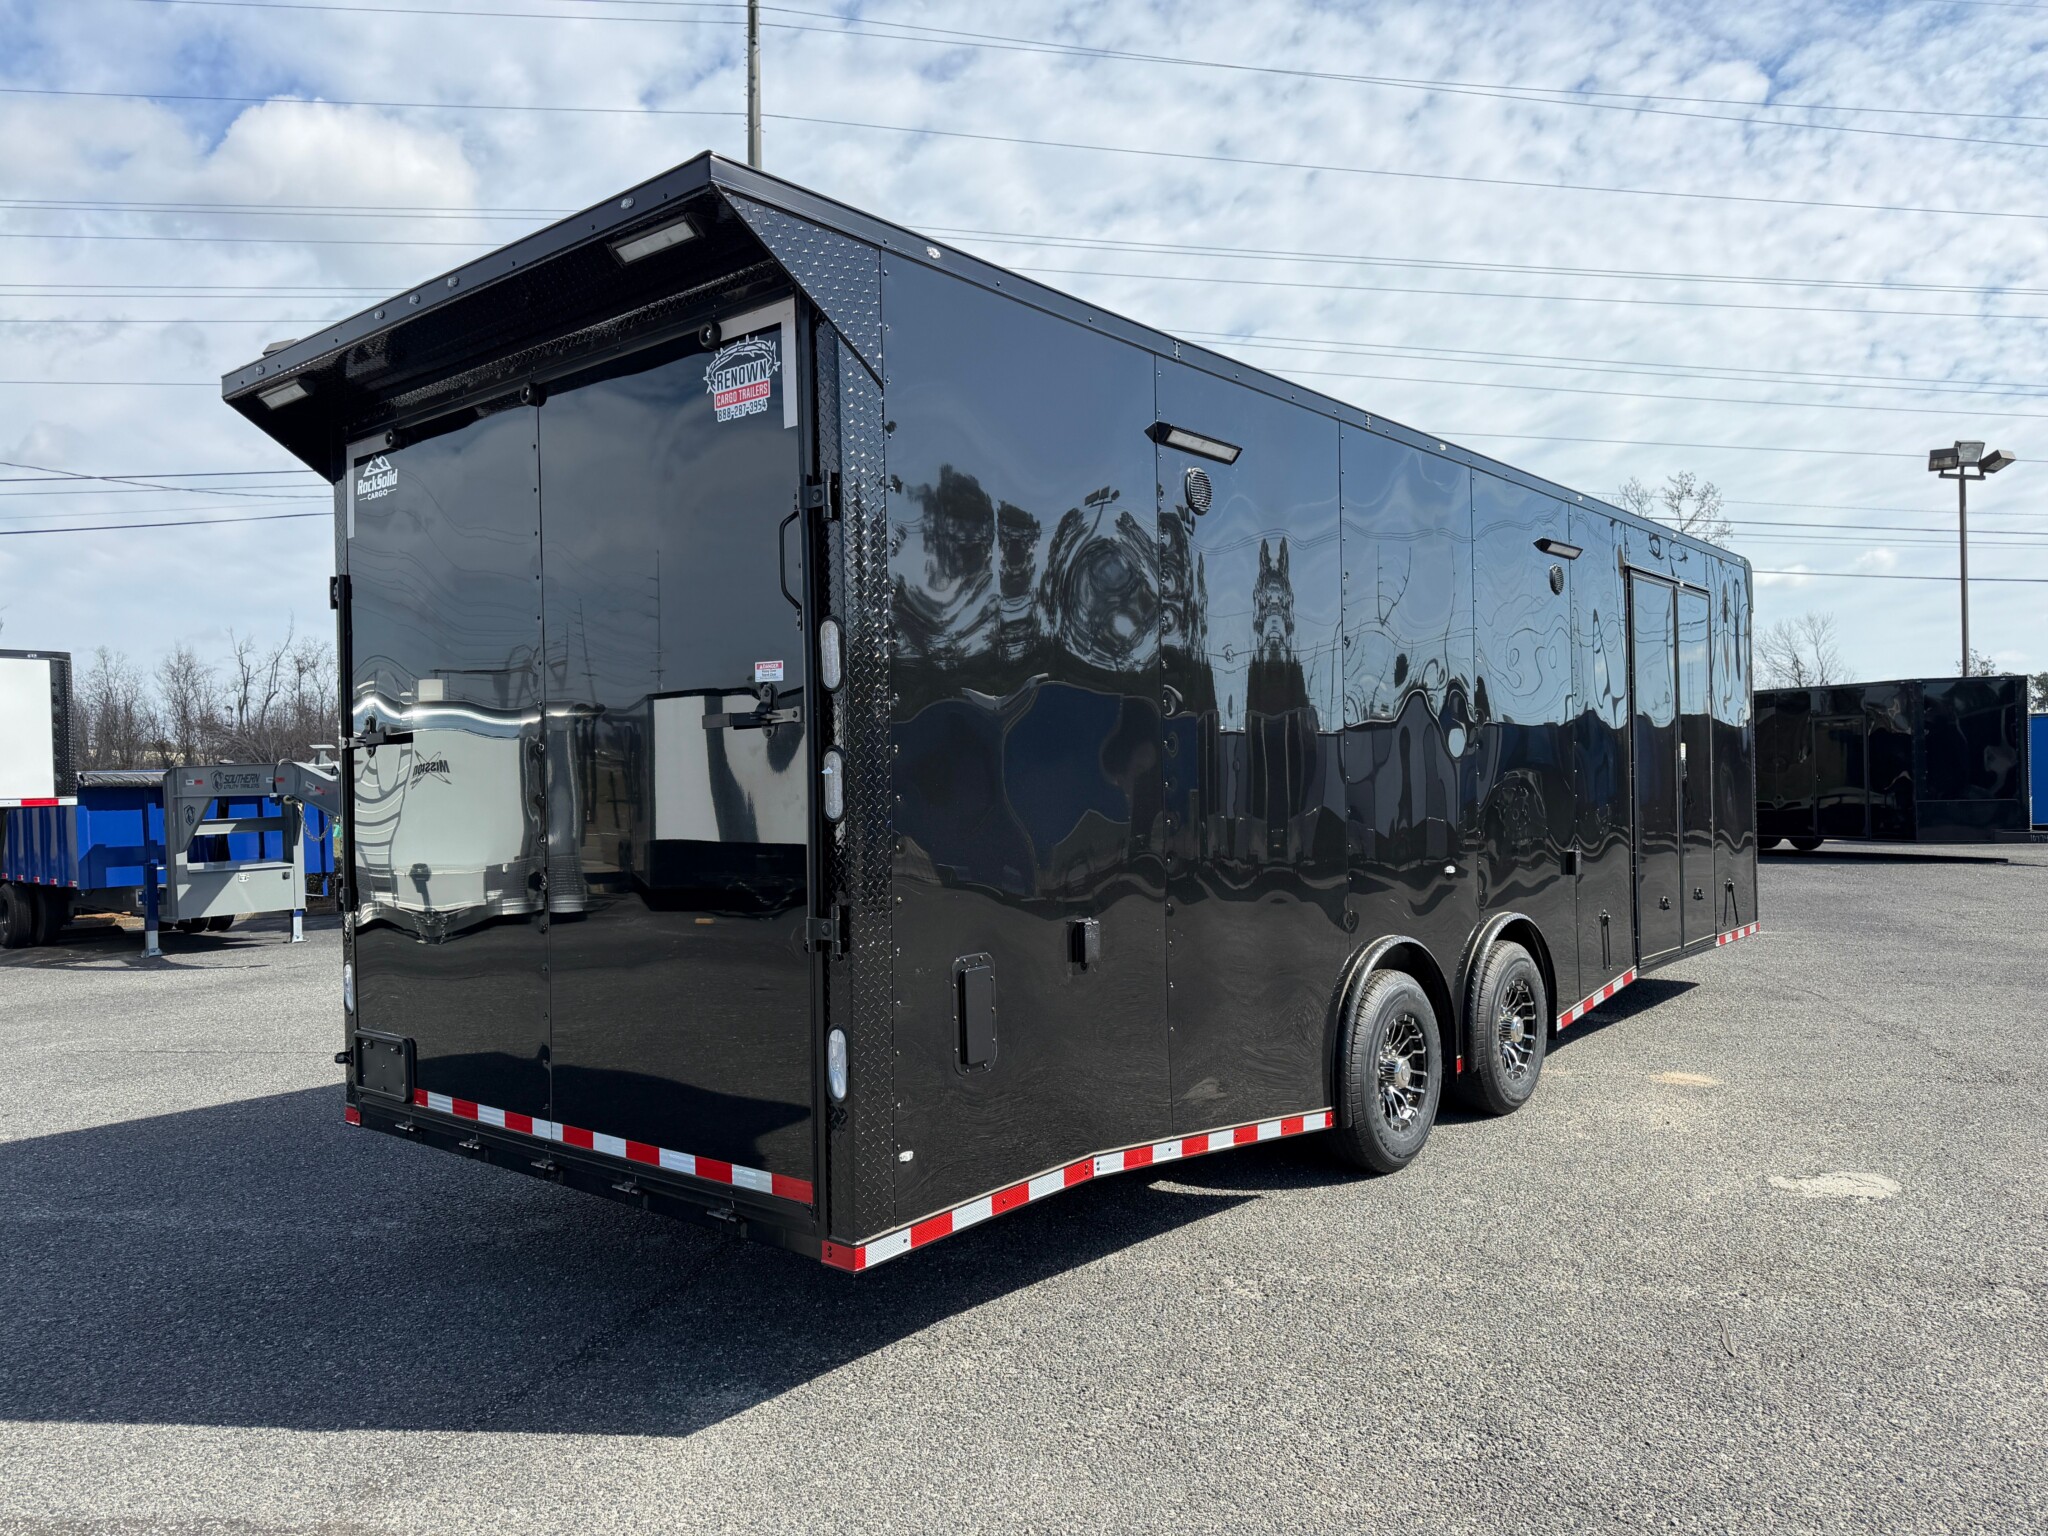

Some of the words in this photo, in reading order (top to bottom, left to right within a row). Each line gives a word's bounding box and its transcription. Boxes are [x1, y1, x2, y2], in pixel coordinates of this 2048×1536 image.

[716, 359, 768, 391] RENOWN
[716, 391, 738, 407] CARGO
[739, 382, 768, 401] TRAILERS
[718, 399, 767, 420] 888-287-3954
[357, 468, 398, 495] RockSolid
[367, 489, 388, 500] CARGO
[223, 773, 260, 783] SOUTHERN
